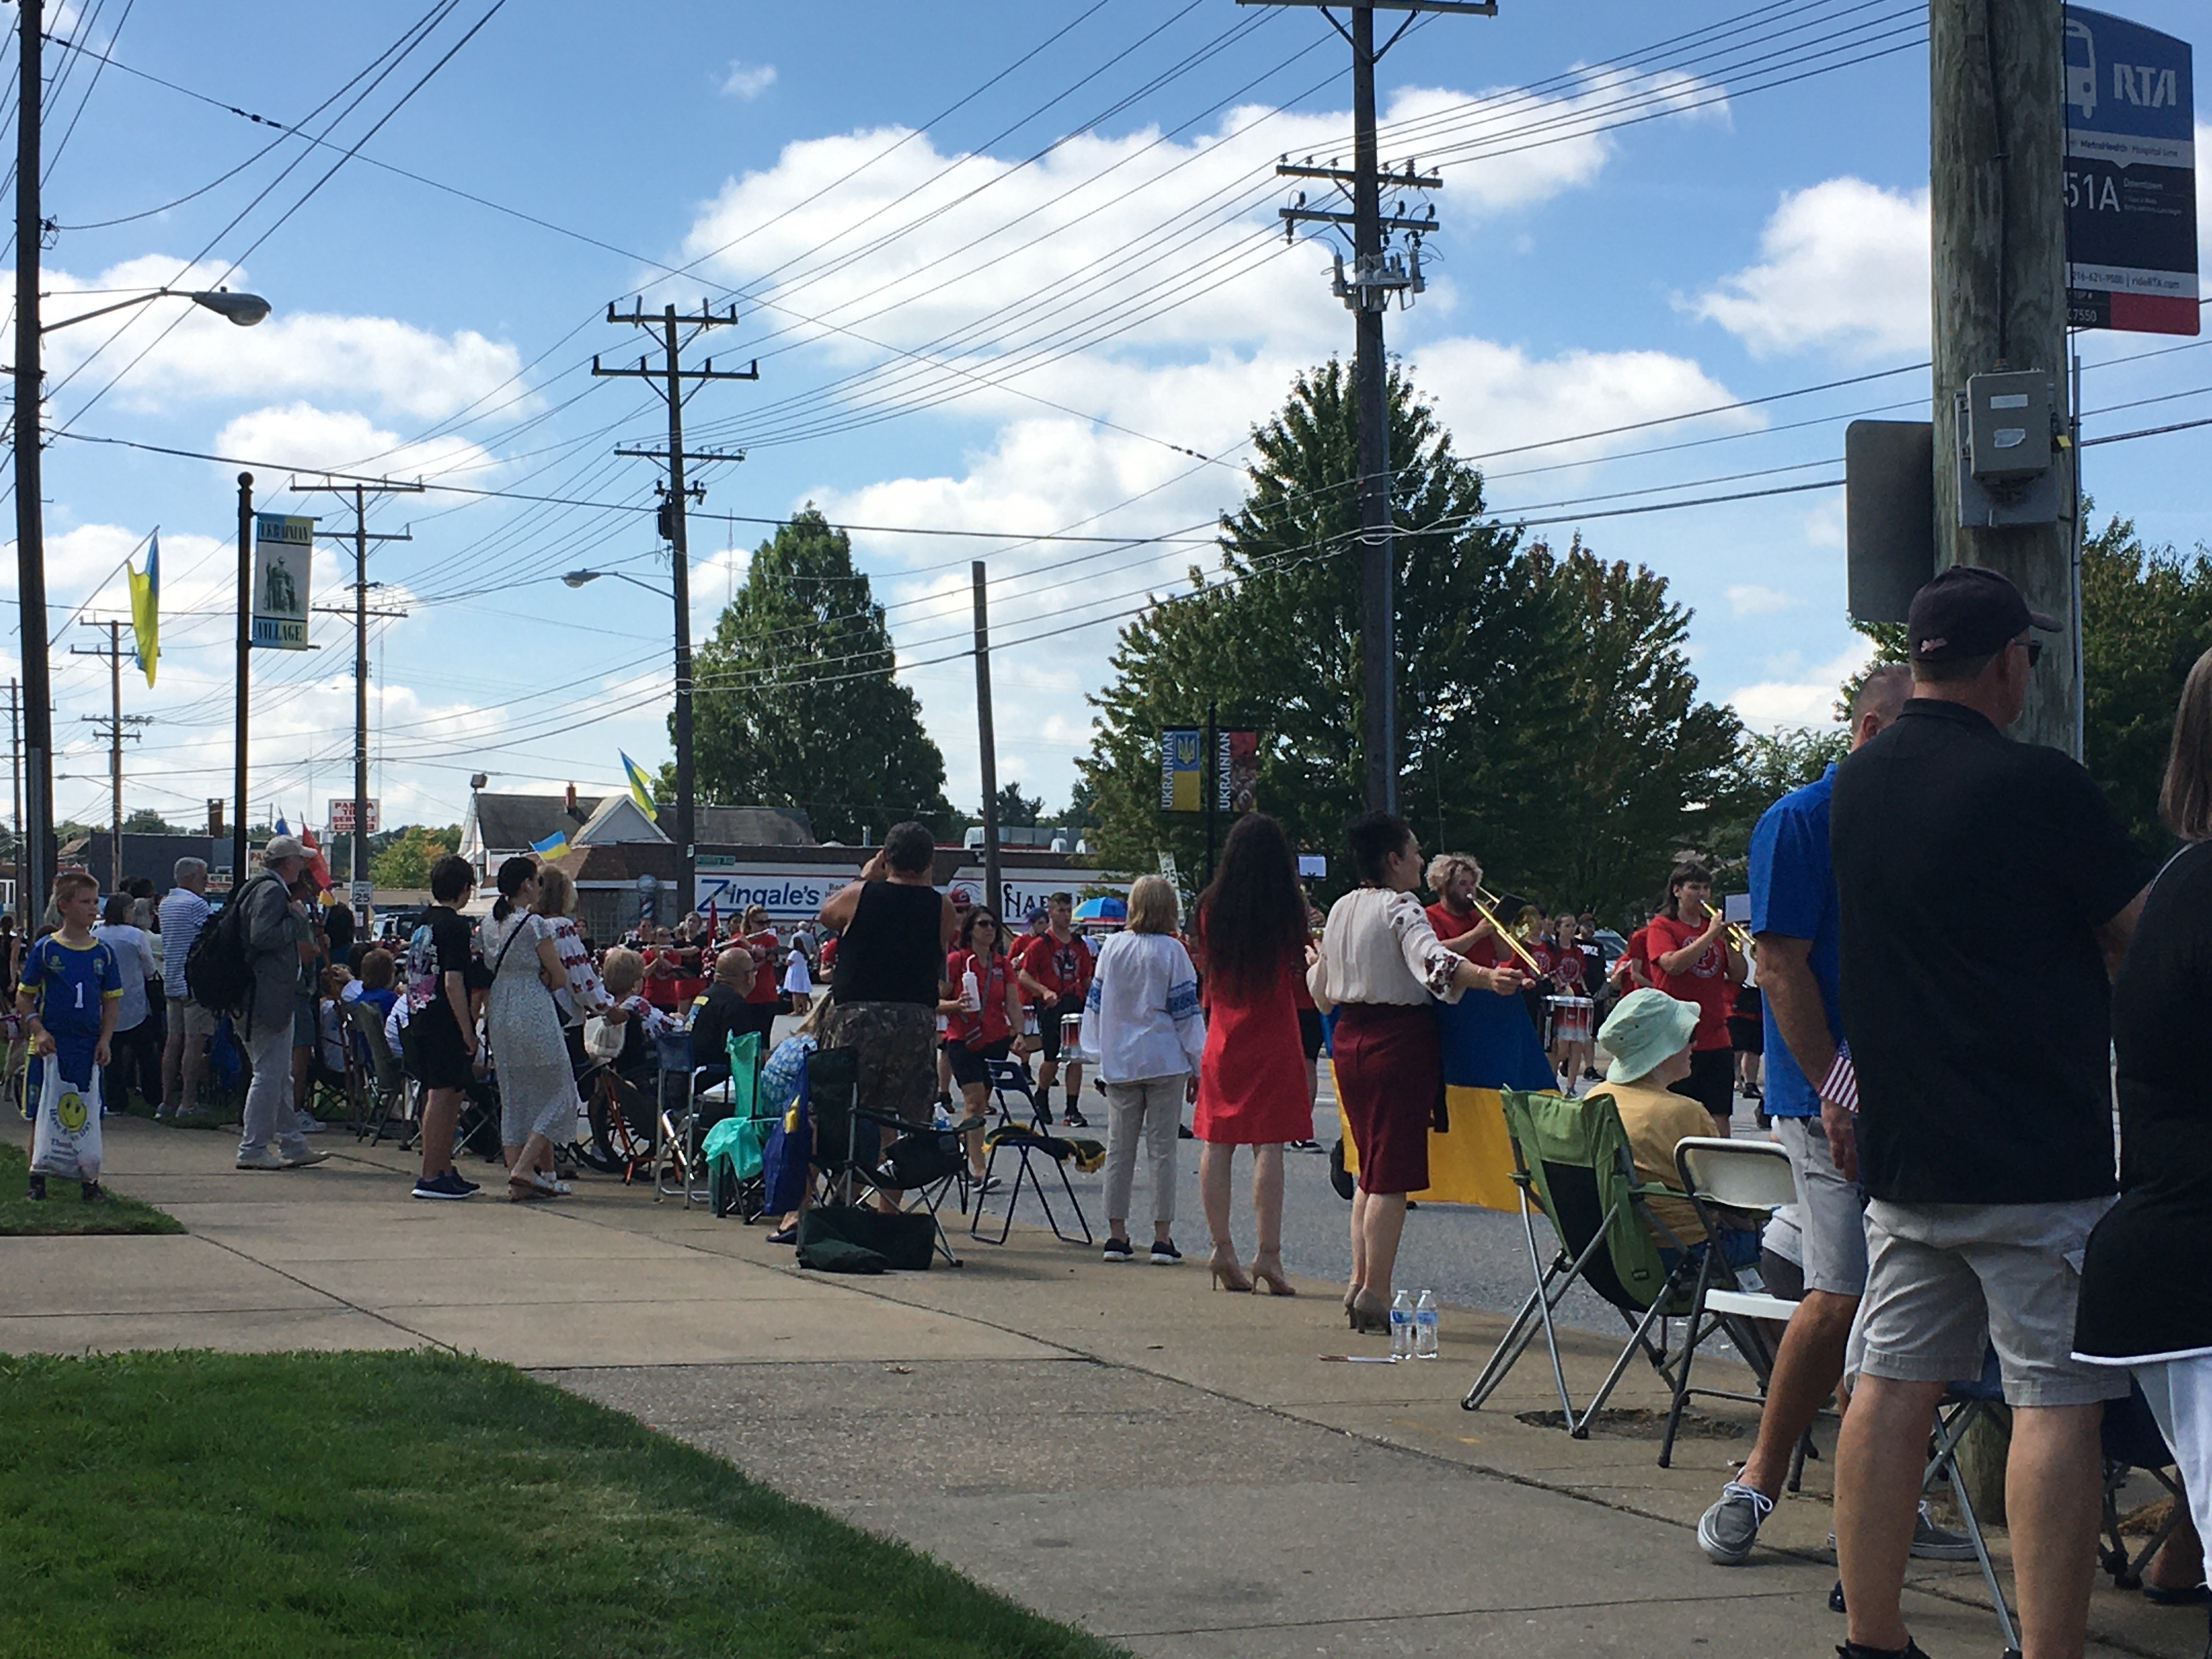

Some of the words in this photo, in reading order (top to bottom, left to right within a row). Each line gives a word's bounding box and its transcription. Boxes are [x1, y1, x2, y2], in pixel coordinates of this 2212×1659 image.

[2113, 63, 2176, 108] RTA
[2063, 171, 2121, 213] 51A
[256, 622, 302, 642] VILLAGE
[1162, 731, 1173, 809] UKRAINIAN
[1220, 732, 1231, 811] UKRAINIAN
[1163, 869, 1176, 883] 25
[355, 893, 370, 902] 25
[697, 879, 820, 912] Zingale's
[74, 981, 84, 1008] 1
